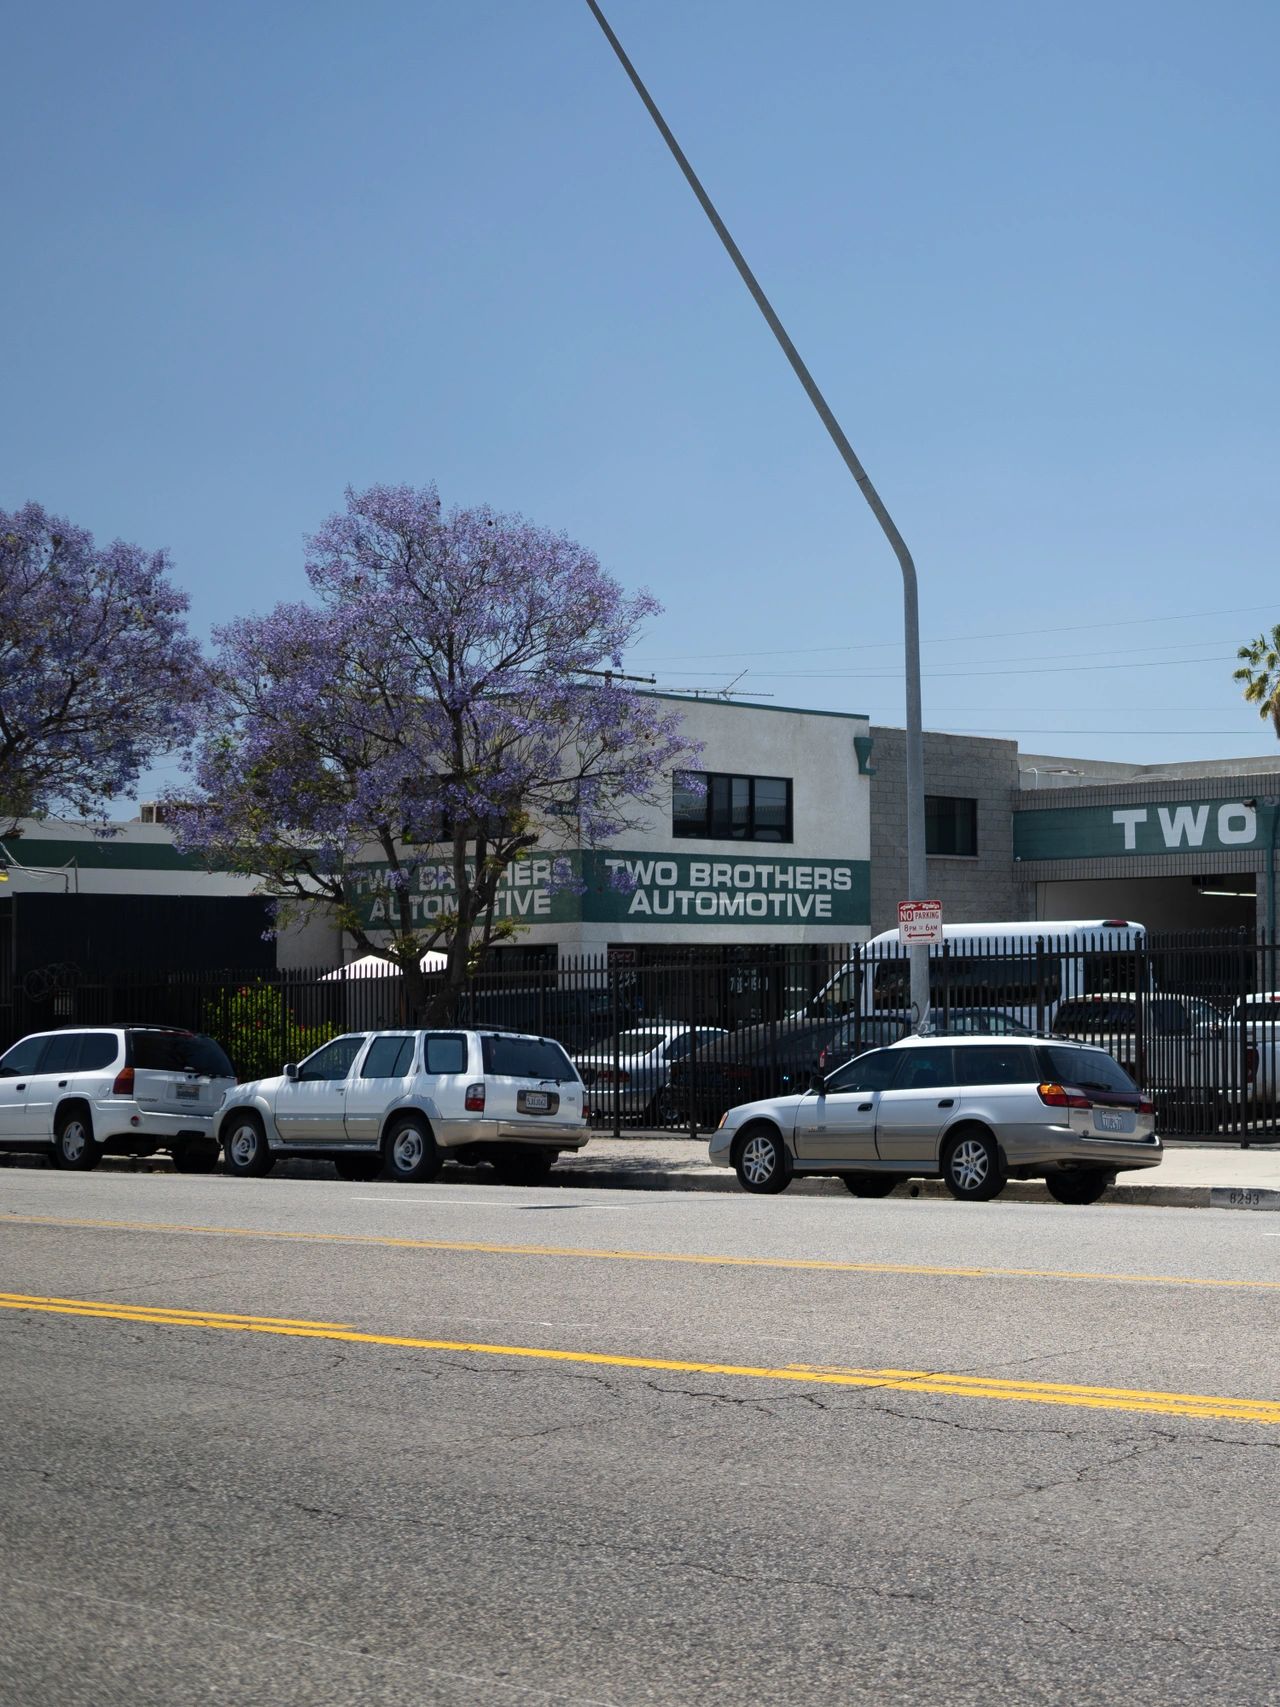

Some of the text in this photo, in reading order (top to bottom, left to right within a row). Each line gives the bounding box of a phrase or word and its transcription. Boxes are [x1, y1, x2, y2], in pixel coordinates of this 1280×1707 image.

[1112, 803, 1257, 850] TWO
[605, 859, 852, 891] TWO BROTHERS
[627, 889, 832, 918] AUTOMOTIVE
[900, 910, 939, 921] NO PARKING
[904, 924, 917, 932] 8PM
[925, 923, 938, 931] 6AM
[1229, 1192, 1260, 1205] 8293
